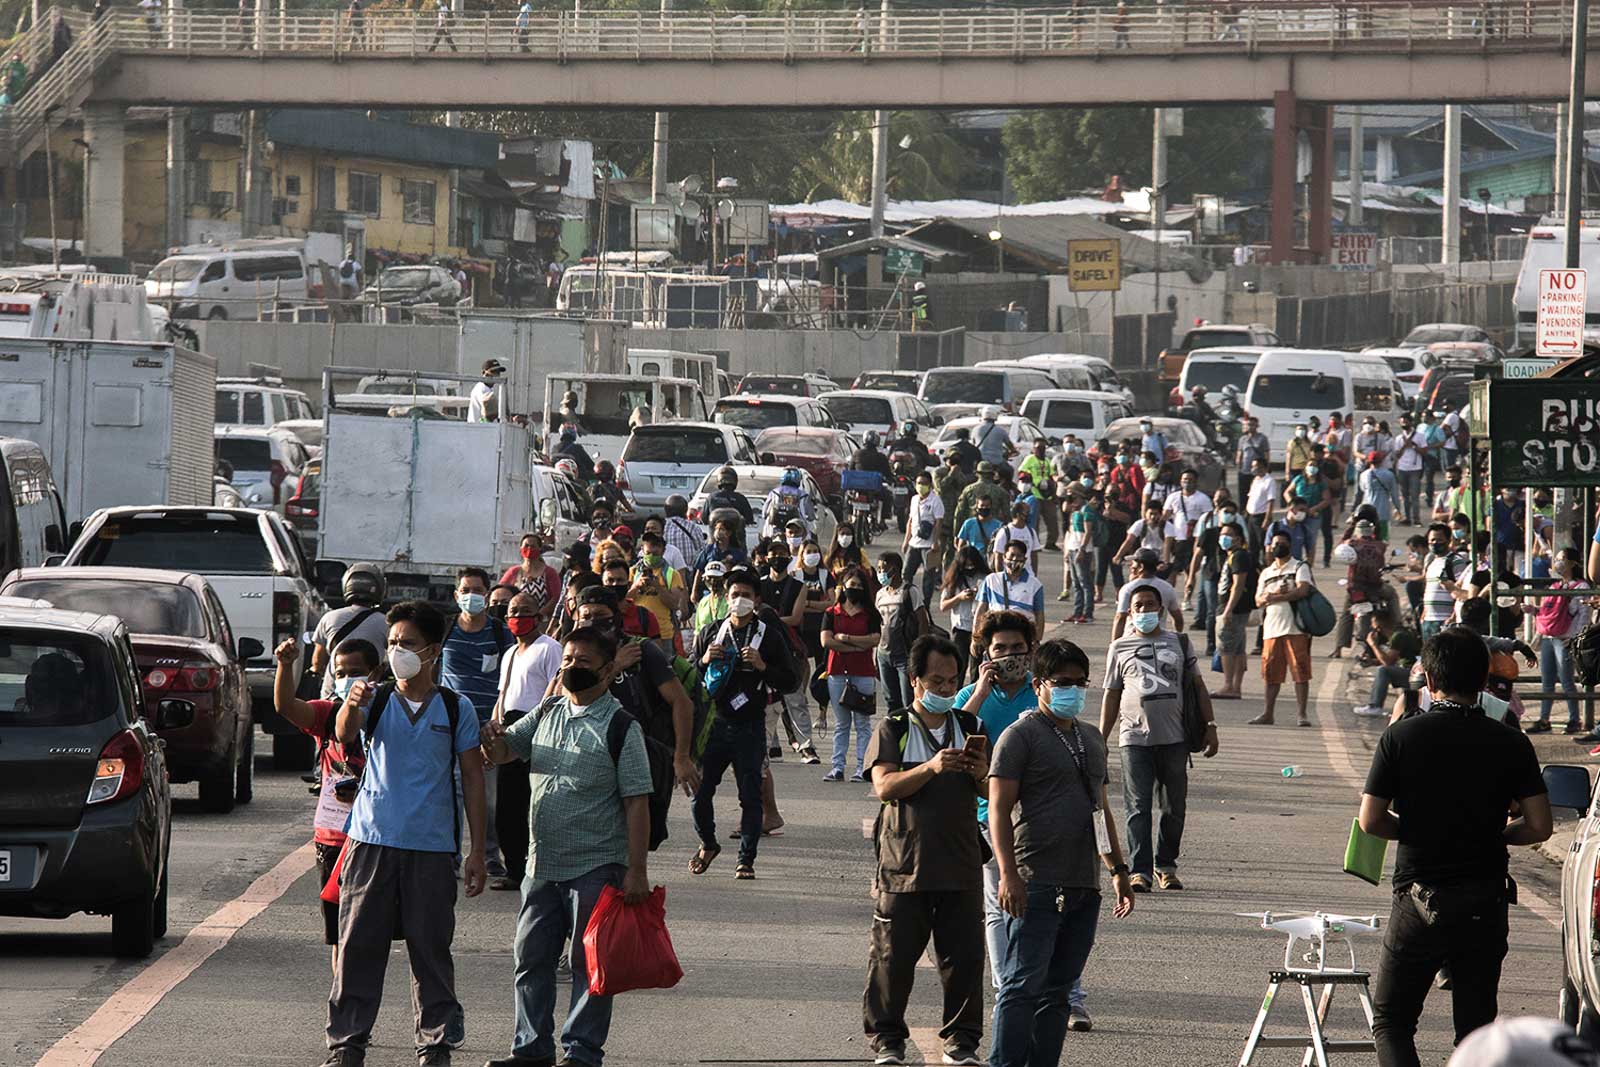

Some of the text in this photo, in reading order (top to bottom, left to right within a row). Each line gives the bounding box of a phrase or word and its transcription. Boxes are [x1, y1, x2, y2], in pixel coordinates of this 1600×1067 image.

[1330, 233, 1376, 248] ENTRY
[1074, 250, 1113, 263] DRIVE
[1339, 249, 1368, 264] EXIT
[1073, 269, 1114, 281] SAFELY
[1549, 272, 1577, 290] NO
[1547, 292, 1583, 303] PARKING
[1546, 305, 1583, 315] WAITING
[1545, 317, 1581, 328] VENDORS
[1545, 330, 1577, 338] ANYTIME
[1508, 366, 1551, 377] LOADIN
